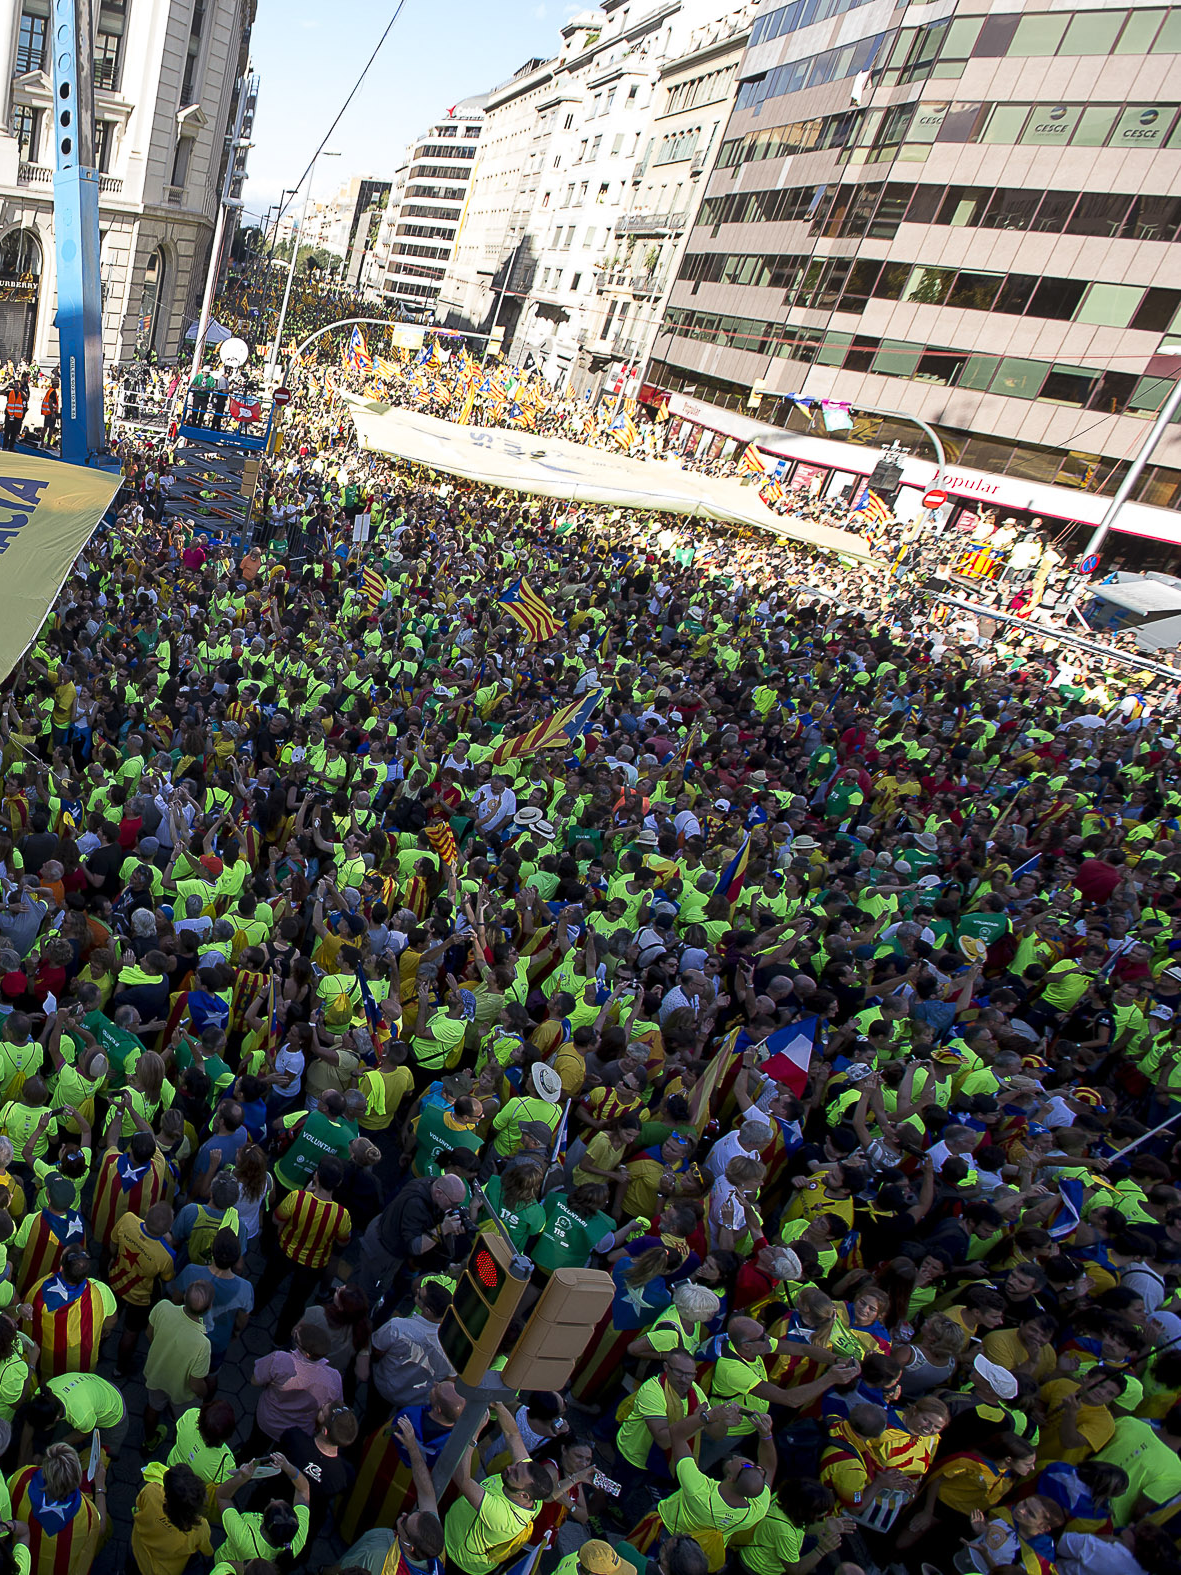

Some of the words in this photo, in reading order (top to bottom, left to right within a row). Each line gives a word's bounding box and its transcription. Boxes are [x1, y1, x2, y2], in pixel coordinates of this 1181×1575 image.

[1034, 124, 1069, 134] CESCE
[1122, 129, 1160, 139] CESCE
[302, 1131, 338, 1155] VOLUNTARI
[557, 1201, 588, 1228] VOLUNTARI
